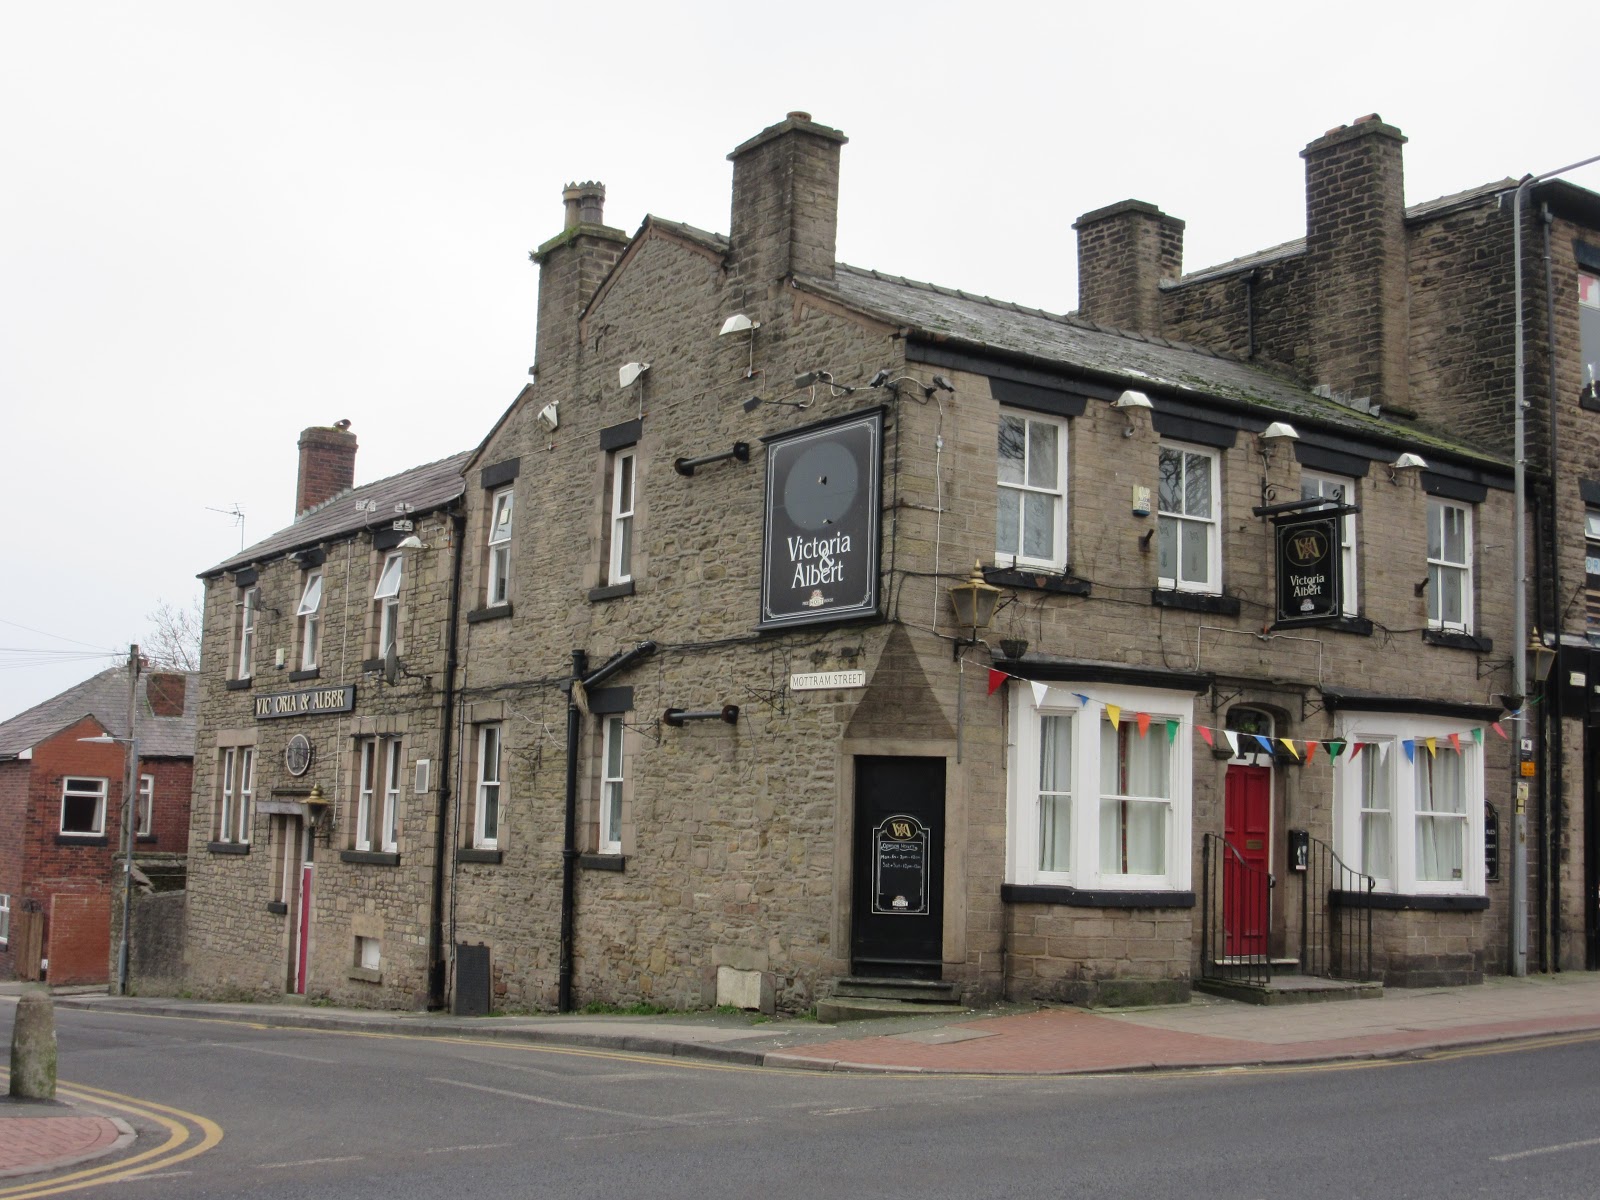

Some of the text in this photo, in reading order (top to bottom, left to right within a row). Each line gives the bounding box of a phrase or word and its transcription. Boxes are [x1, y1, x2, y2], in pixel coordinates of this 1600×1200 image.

[787, 531, 851, 562] Victoria
[819, 547, 834, 574] &
[791, 560, 844, 589] Albert
[1290, 573, 1325, 587] Victoria
[1293, 585, 1321, 598] Albert
[793, 673, 862, 687] MOTTRAM STREET
[300, 693, 310, 711] &
